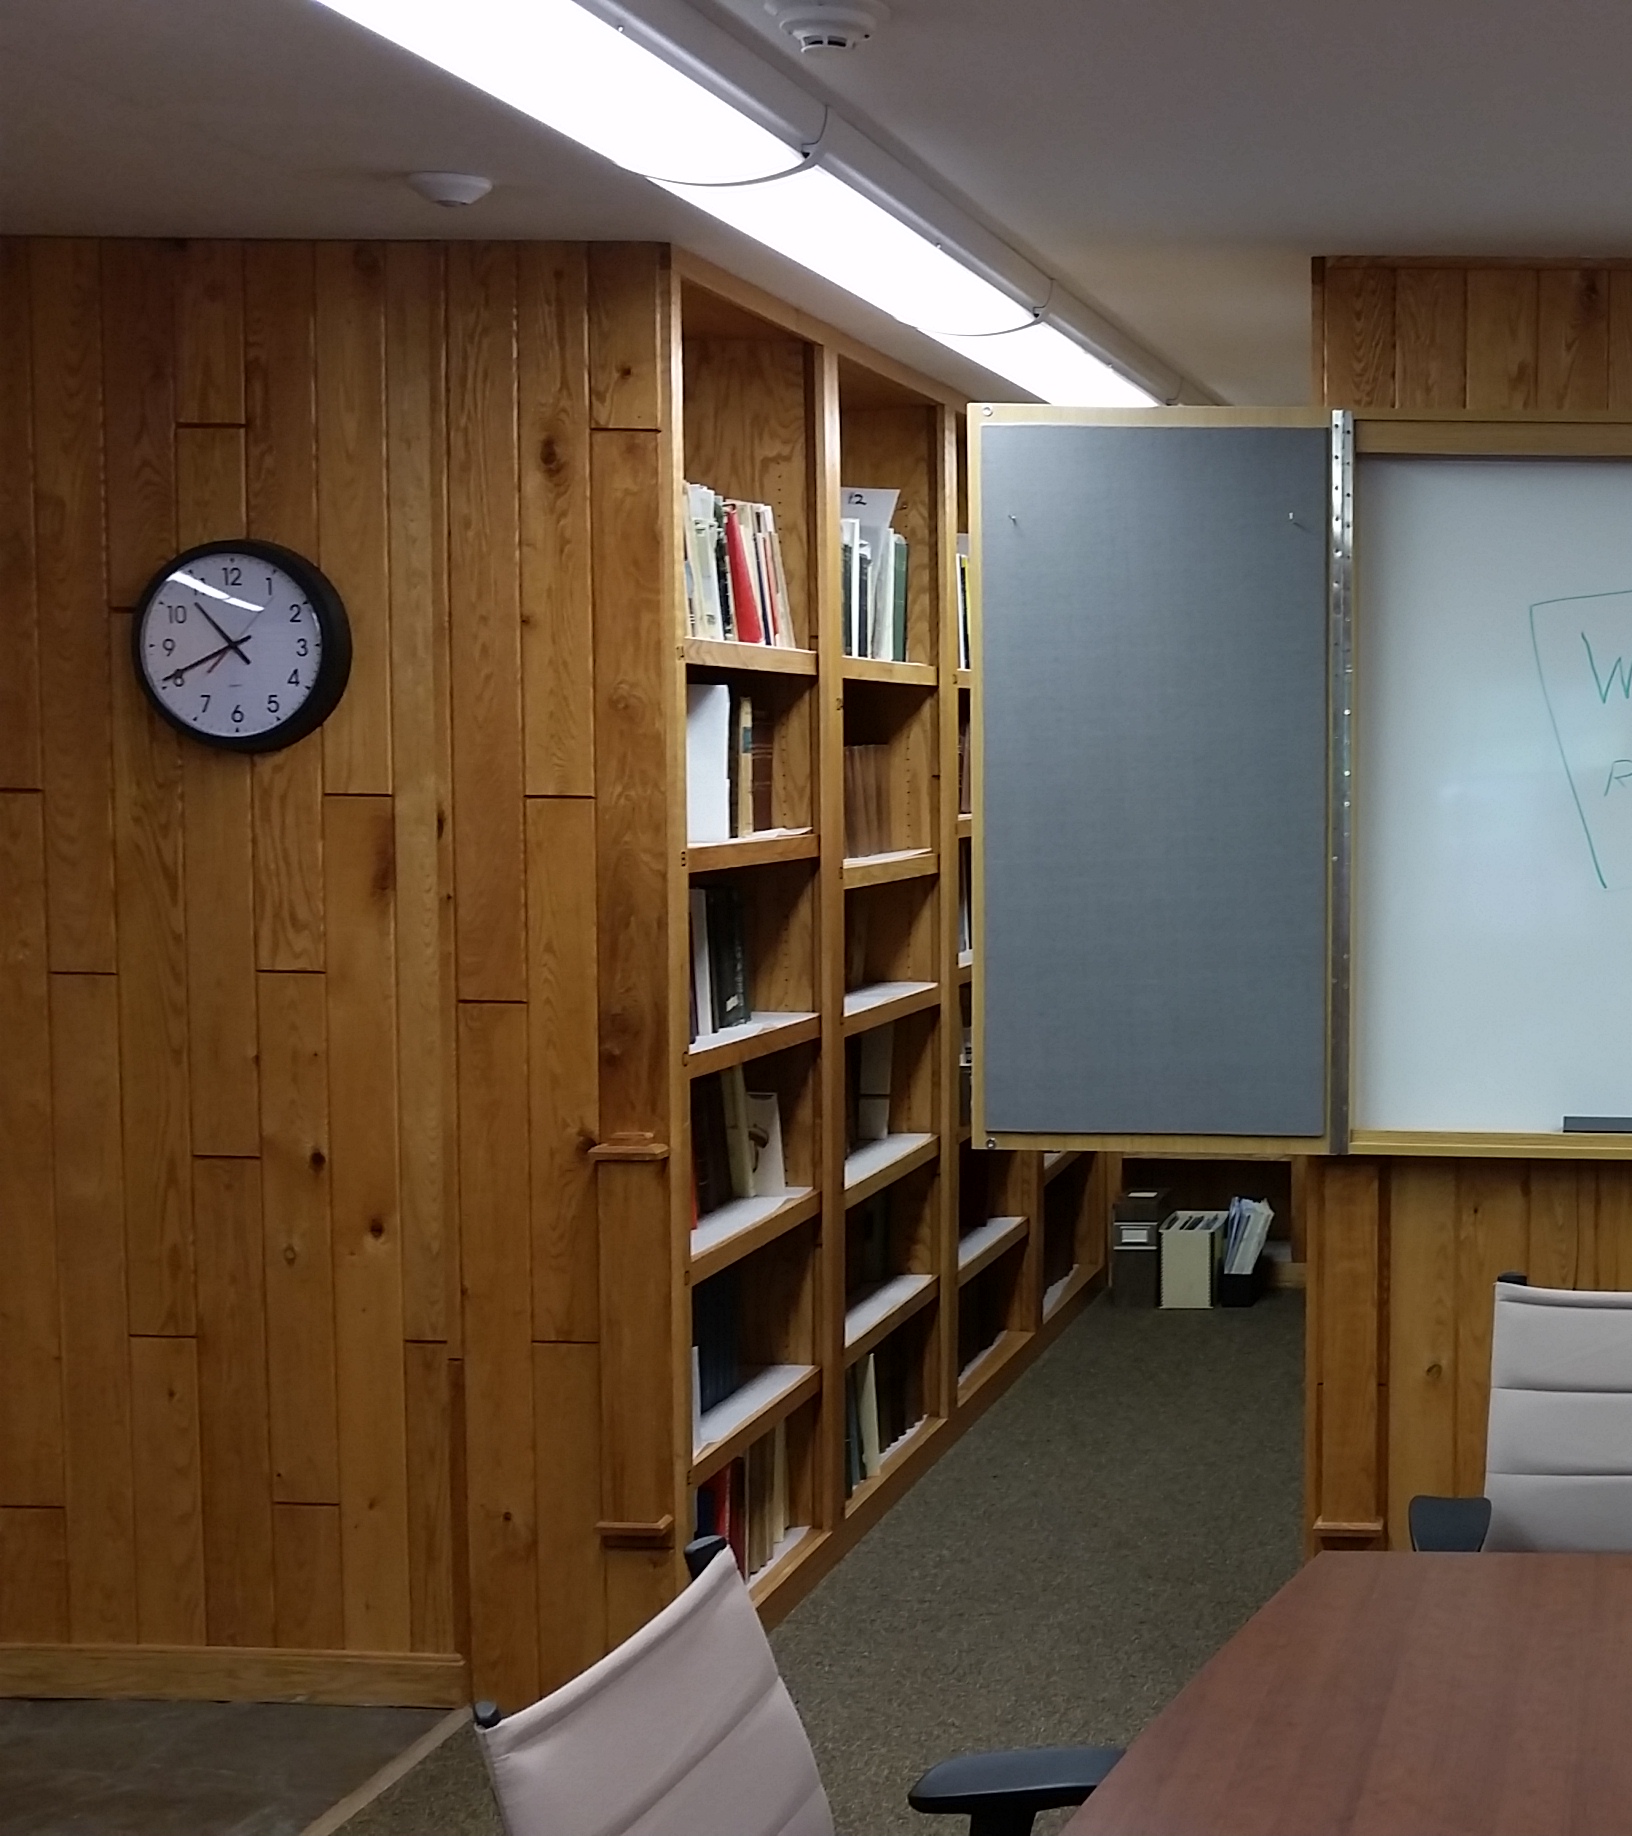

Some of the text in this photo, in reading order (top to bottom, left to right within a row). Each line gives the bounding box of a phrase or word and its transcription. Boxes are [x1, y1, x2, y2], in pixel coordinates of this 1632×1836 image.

[222, 567, 243, 586] 12
[265, 577, 273, 596] 1
[167, 605, 187, 624] 10
[289, 604, 302, 623] 2
[162, 638, 176, 657] 9
[296, 638, 309, 657] 3
[287, 668, 300, 686] 4
[200, 694, 211, 713] 7
[266, 694, 280, 713] 5
[231, 704, 244, 723] 6
